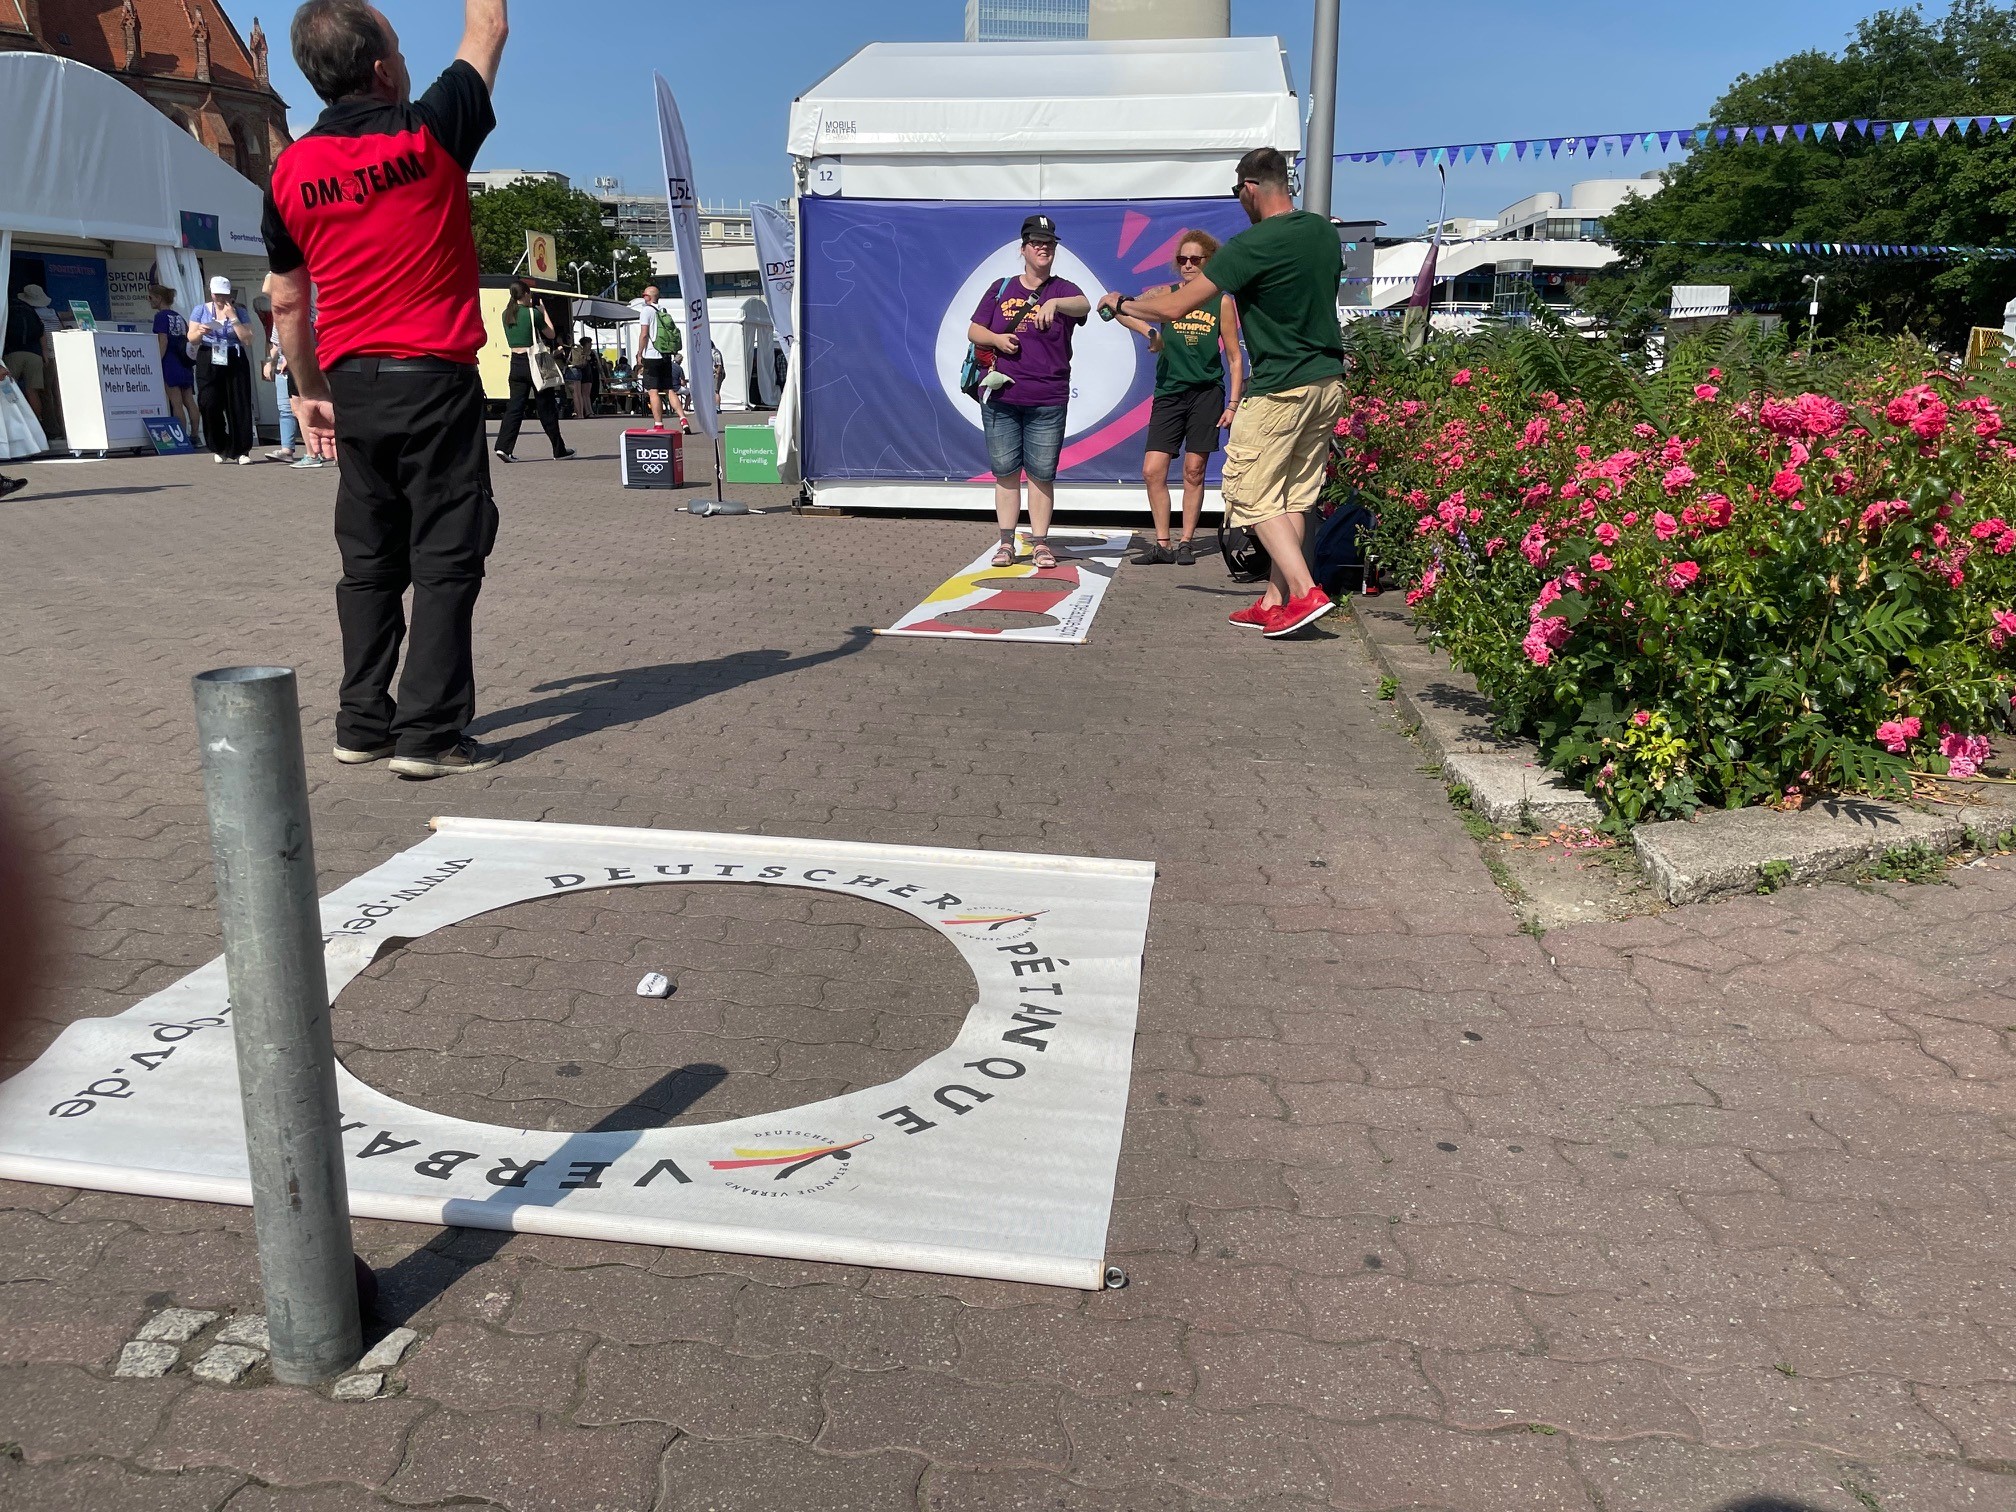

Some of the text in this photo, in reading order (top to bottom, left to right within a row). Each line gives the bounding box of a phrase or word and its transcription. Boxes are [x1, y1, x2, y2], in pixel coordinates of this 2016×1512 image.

[825, 120, 857, 129] MOBILE
[300, 151, 427, 210] DM TEAM
[819, 170, 834, 182] 12
[108, 271, 151, 282] SPECIAL
[1173, 321, 1212, 333] OLYMPICS
[100, 346, 145, 361] Mehr Sport.
[102, 363, 154, 376] Mehr Vielfalt.
[104, 381, 151, 393] Mehr Berlin.
[636, 448, 669, 460] DOSB
[545, 863, 963, 911] DEUTSCHER
[876, 941, 1071, 1136] PÉTANQUE
[754, 1129, 836, 1146] DEUTSCHER
[339, 1111, 693, 1189] VERBA
[724, 1180, 790, 1198] VERBAND
